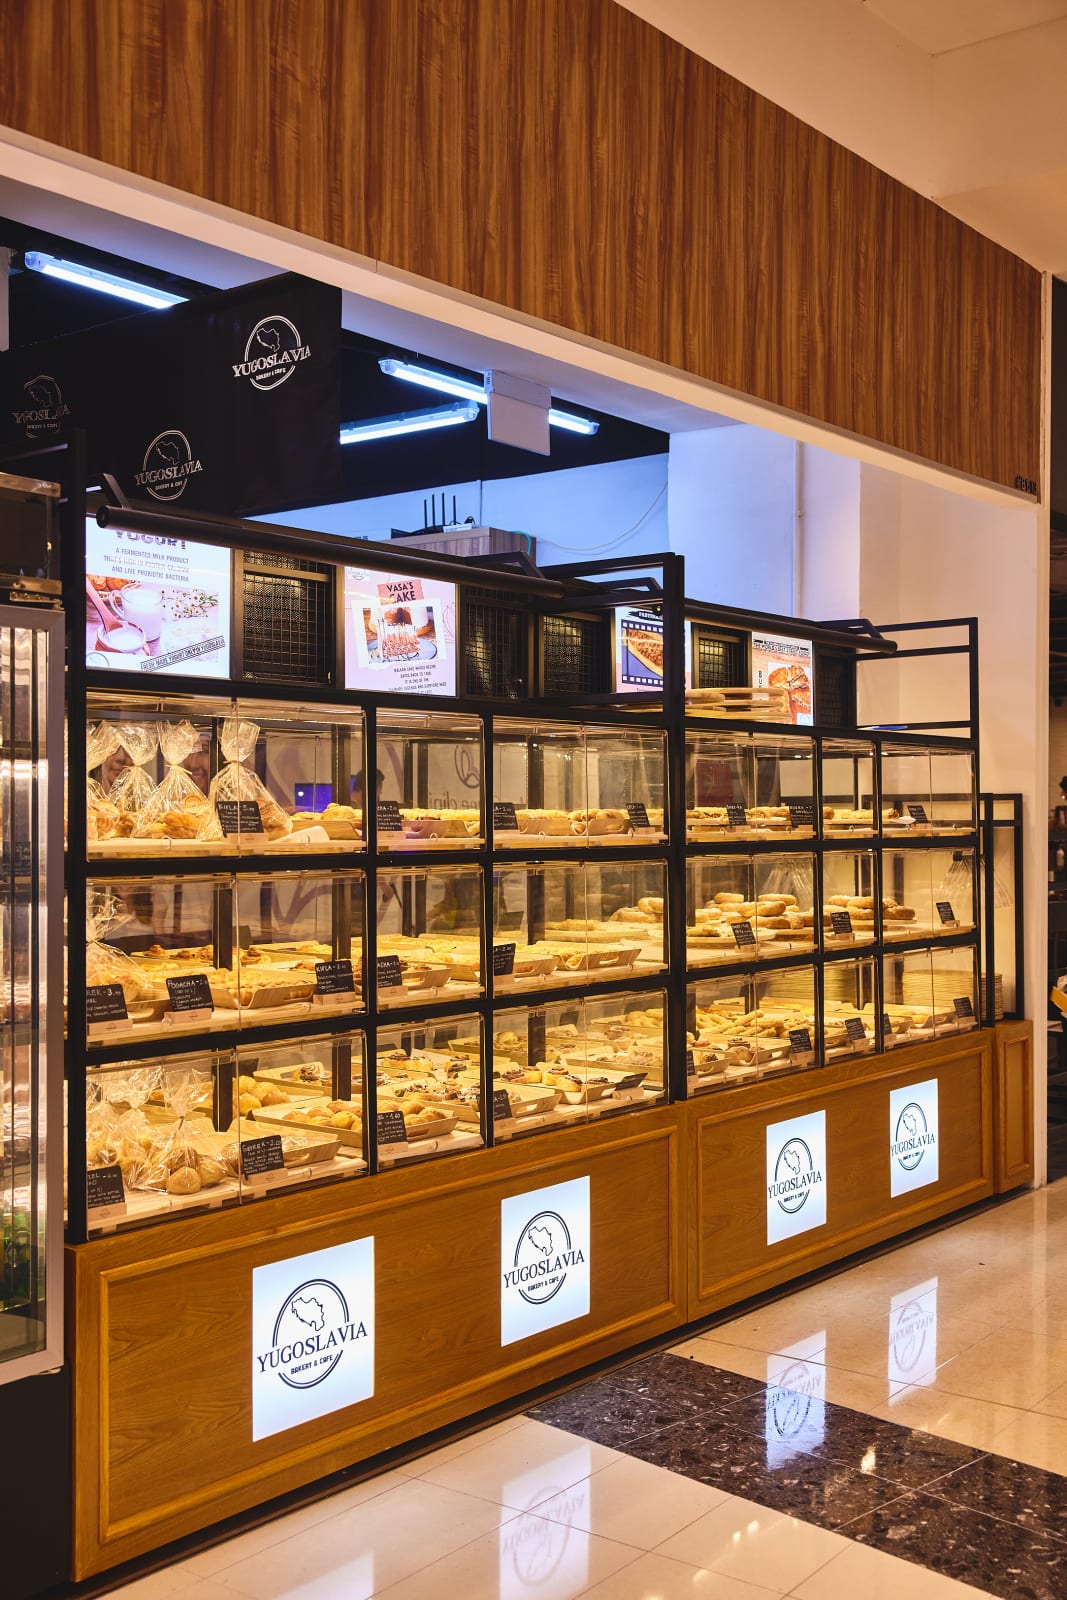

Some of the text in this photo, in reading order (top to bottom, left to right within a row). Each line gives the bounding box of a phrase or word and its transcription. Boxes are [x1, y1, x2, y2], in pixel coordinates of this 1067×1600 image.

[232, 344, 312, 377] YUGOSLAVIA
[134, 460, 204, 486] YUGOSLAVIA
[122, 548, 151, 558] FERMENTED
[166, 556, 189, 564] PRODUCT
[138, 569, 164, 578] PROBIOTIC
[165, 574, 188, 582] BACTERIA
[386, 582, 414, 592] VASA'S
[890, 1133, 936, 1157] YUGOSLAVIA
[768, 1170, 823, 1199] YUGOSLAVIA
[503, 1249, 585, 1289] YUGOSLAVIA
[527, 1281, 544, 1292] BAKERY
[548, 1276, 559, 1284] CAFE
[256, 1320, 368, 1374] YUGOSLAVIA
[290, 1362, 312, 1375] BAKERY
[319, 1354, 334, 1365] CAFE
